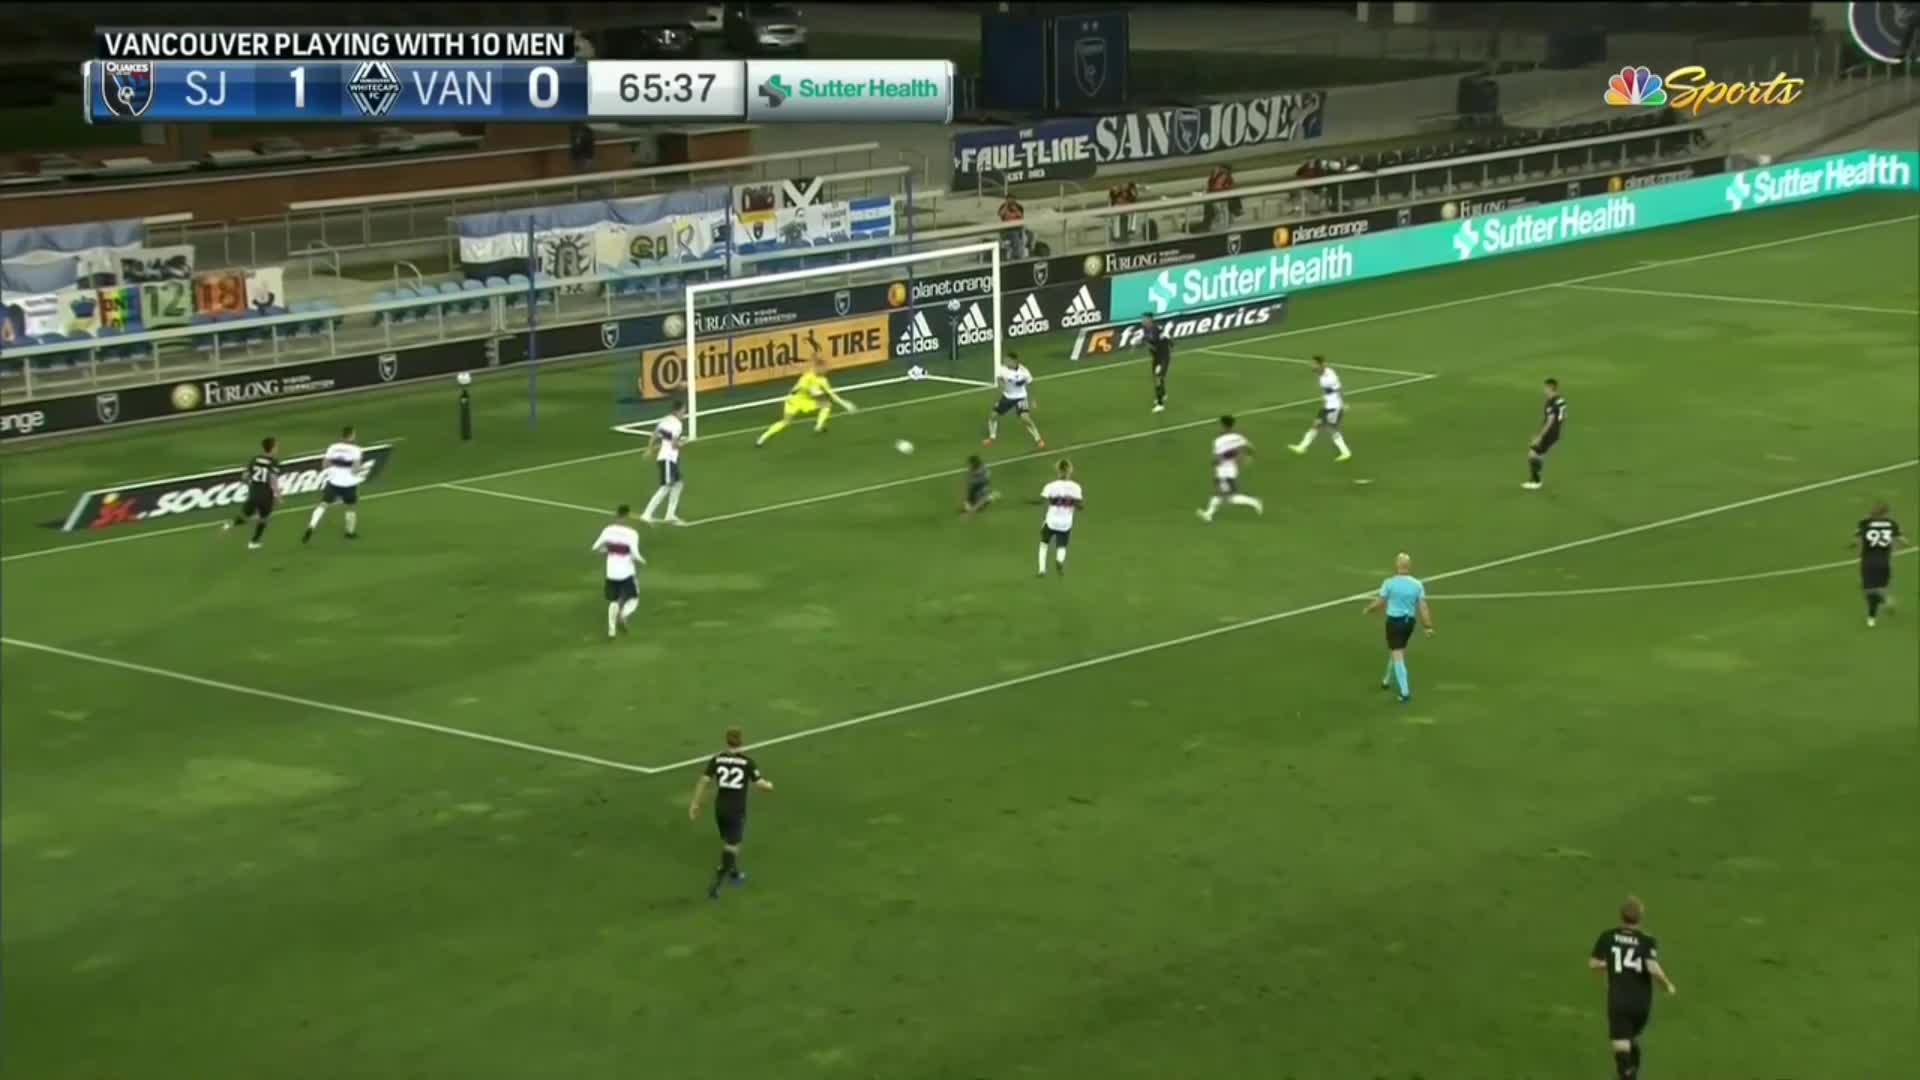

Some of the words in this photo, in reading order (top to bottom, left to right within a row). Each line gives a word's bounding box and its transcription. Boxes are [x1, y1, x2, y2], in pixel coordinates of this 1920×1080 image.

[1095, 108, 1174, 163] SAN
[1200, 94, 1293, 152] JOSE
[1754, 166, 1824, 205] Sutter
[1825, 154, 1910, 192] Health
[1482, 213, 1557, 252] Sutter
[1561, 196, 1636, 240] Health
[912, 281, 952, 301] planet
[953, 275, 993, 293] orang
[1182, 262, 1266, 307] Sutter
[1269, 244, 1353, 291] Health
[143, 280, 186, 318] 12
[1008, 319, 1050, 337] adidas
[1061, 310, 1103, 328] adidas
[1118, 307, 1270, 348] fatmetrics
[827, 328, 881, 358] TIRE
[896, 337, 939, 356] adidas
[958, 327, 993, 346] didas
[204, 379, 279, 406] FURLONG
[251, 465, 269, 483] 21
[1865, 529, 1893, 548] 93
[716, 765, 745, 790] 22
[1611, 945, 1643, 974] 14
